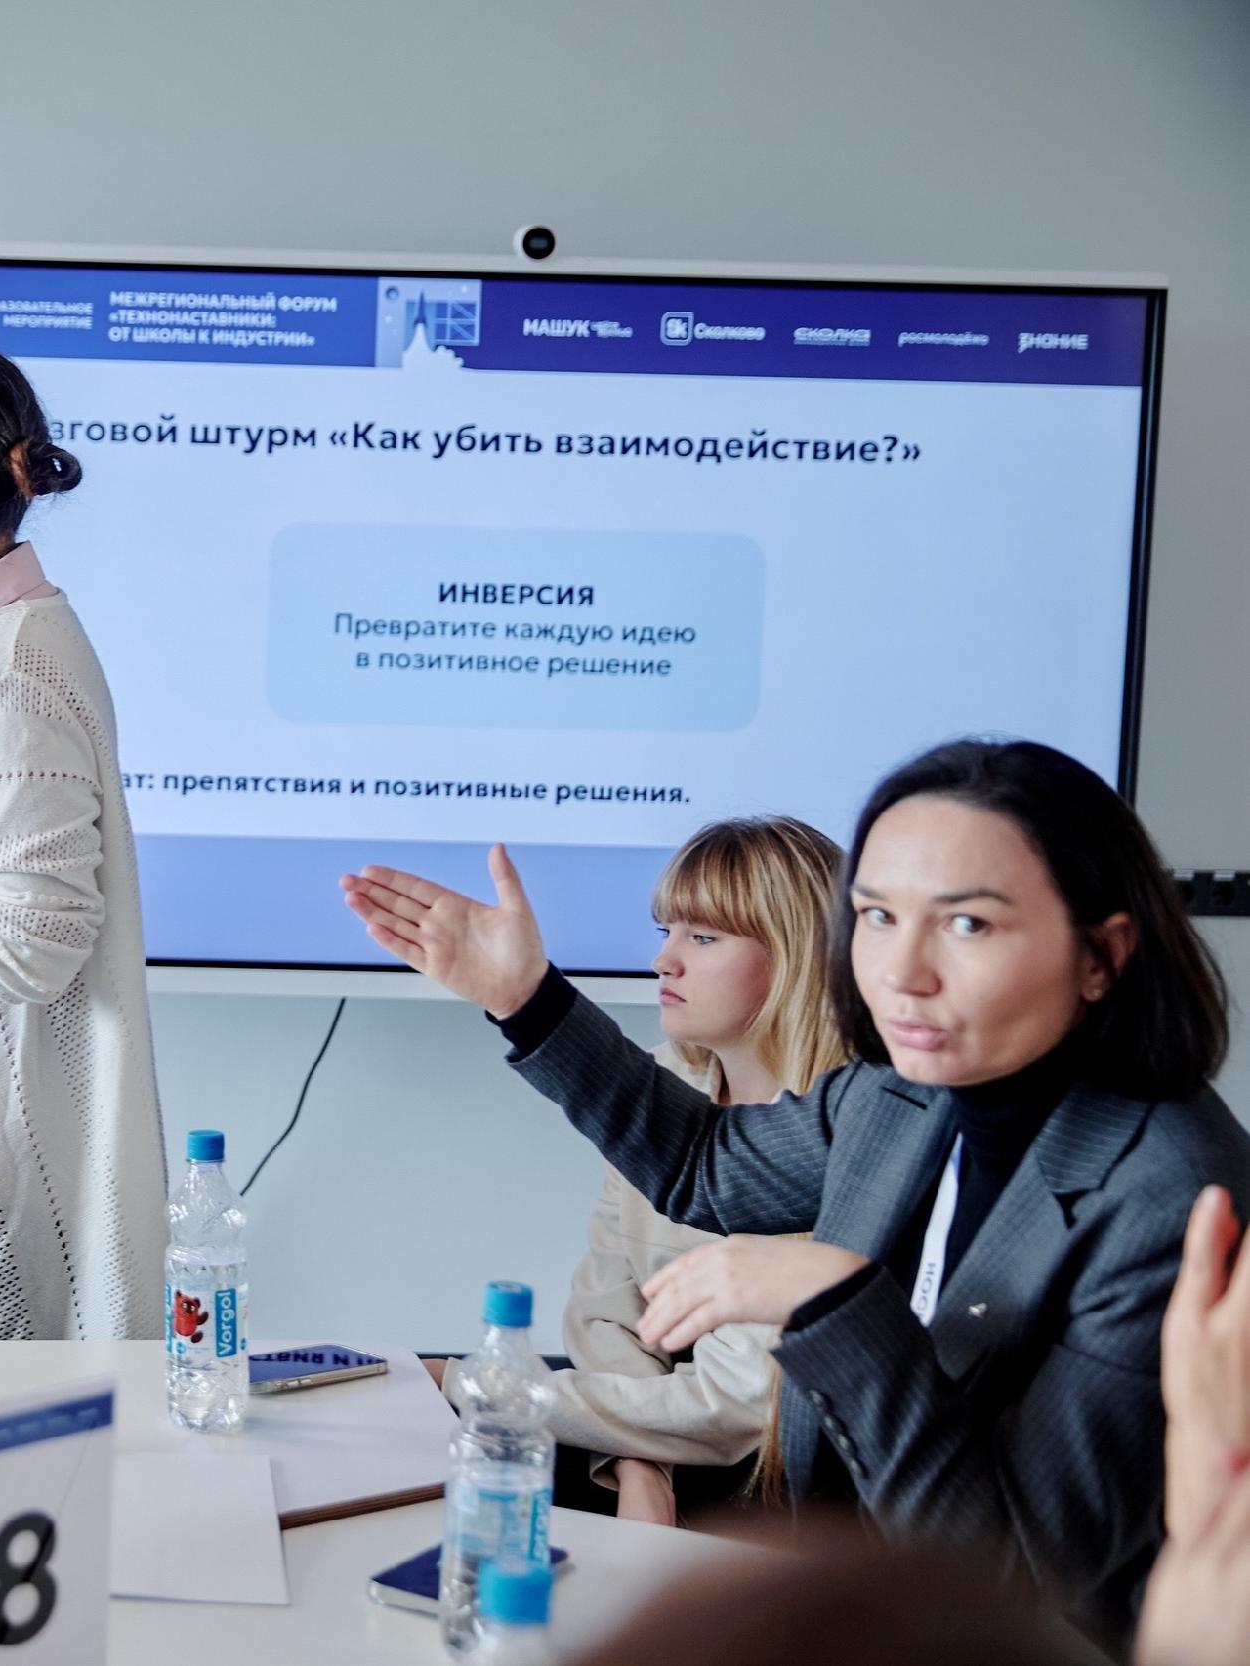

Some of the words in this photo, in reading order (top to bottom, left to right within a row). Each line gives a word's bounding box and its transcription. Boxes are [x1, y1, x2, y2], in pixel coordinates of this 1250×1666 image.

[109, 291, 275, 311] МЕЖРЕГИОНАЛЬНЫЙ
[278, 296, 338, 312] ФОРУМ
[3, 314, 93, 329] МЕРОПРИЯТИЕ
[523, 318, 590, 338] МАШУК
[108, 327, 130, 342] ОТ
[132, 328, 196, 344] ШКОЛЫ
[199, 329, 211, 344] К
[213, 329, 315, 348] ИНДУСТРИИ»
[51, 414, 178, 444] зговой
[190, 423, 317, 454] штурм
[329, 423, 421, 450] «Как
[433, 426, 543, 458] убить
[555, 430, 920, 465] взаимодействие?»
[438, 583, 594, 606] ИНВЕРСИЯ
[334, 612, 497, 640] Превратите
[505, 622, 613, 645] каждую
[621, 624, 696, 645] идею
[356, 652, 369, 668] в
[379, 651, 539, 672] позитивное
[548, 655, 671, 677] решение
[163, 773, 341, 797] препятствия
[350, 778, 365, 795] и
[374, 778, 548, 800] позитивные
[556, 783, 691, 805] решения.
[218, 1291, 234, 1355] Vorgol
